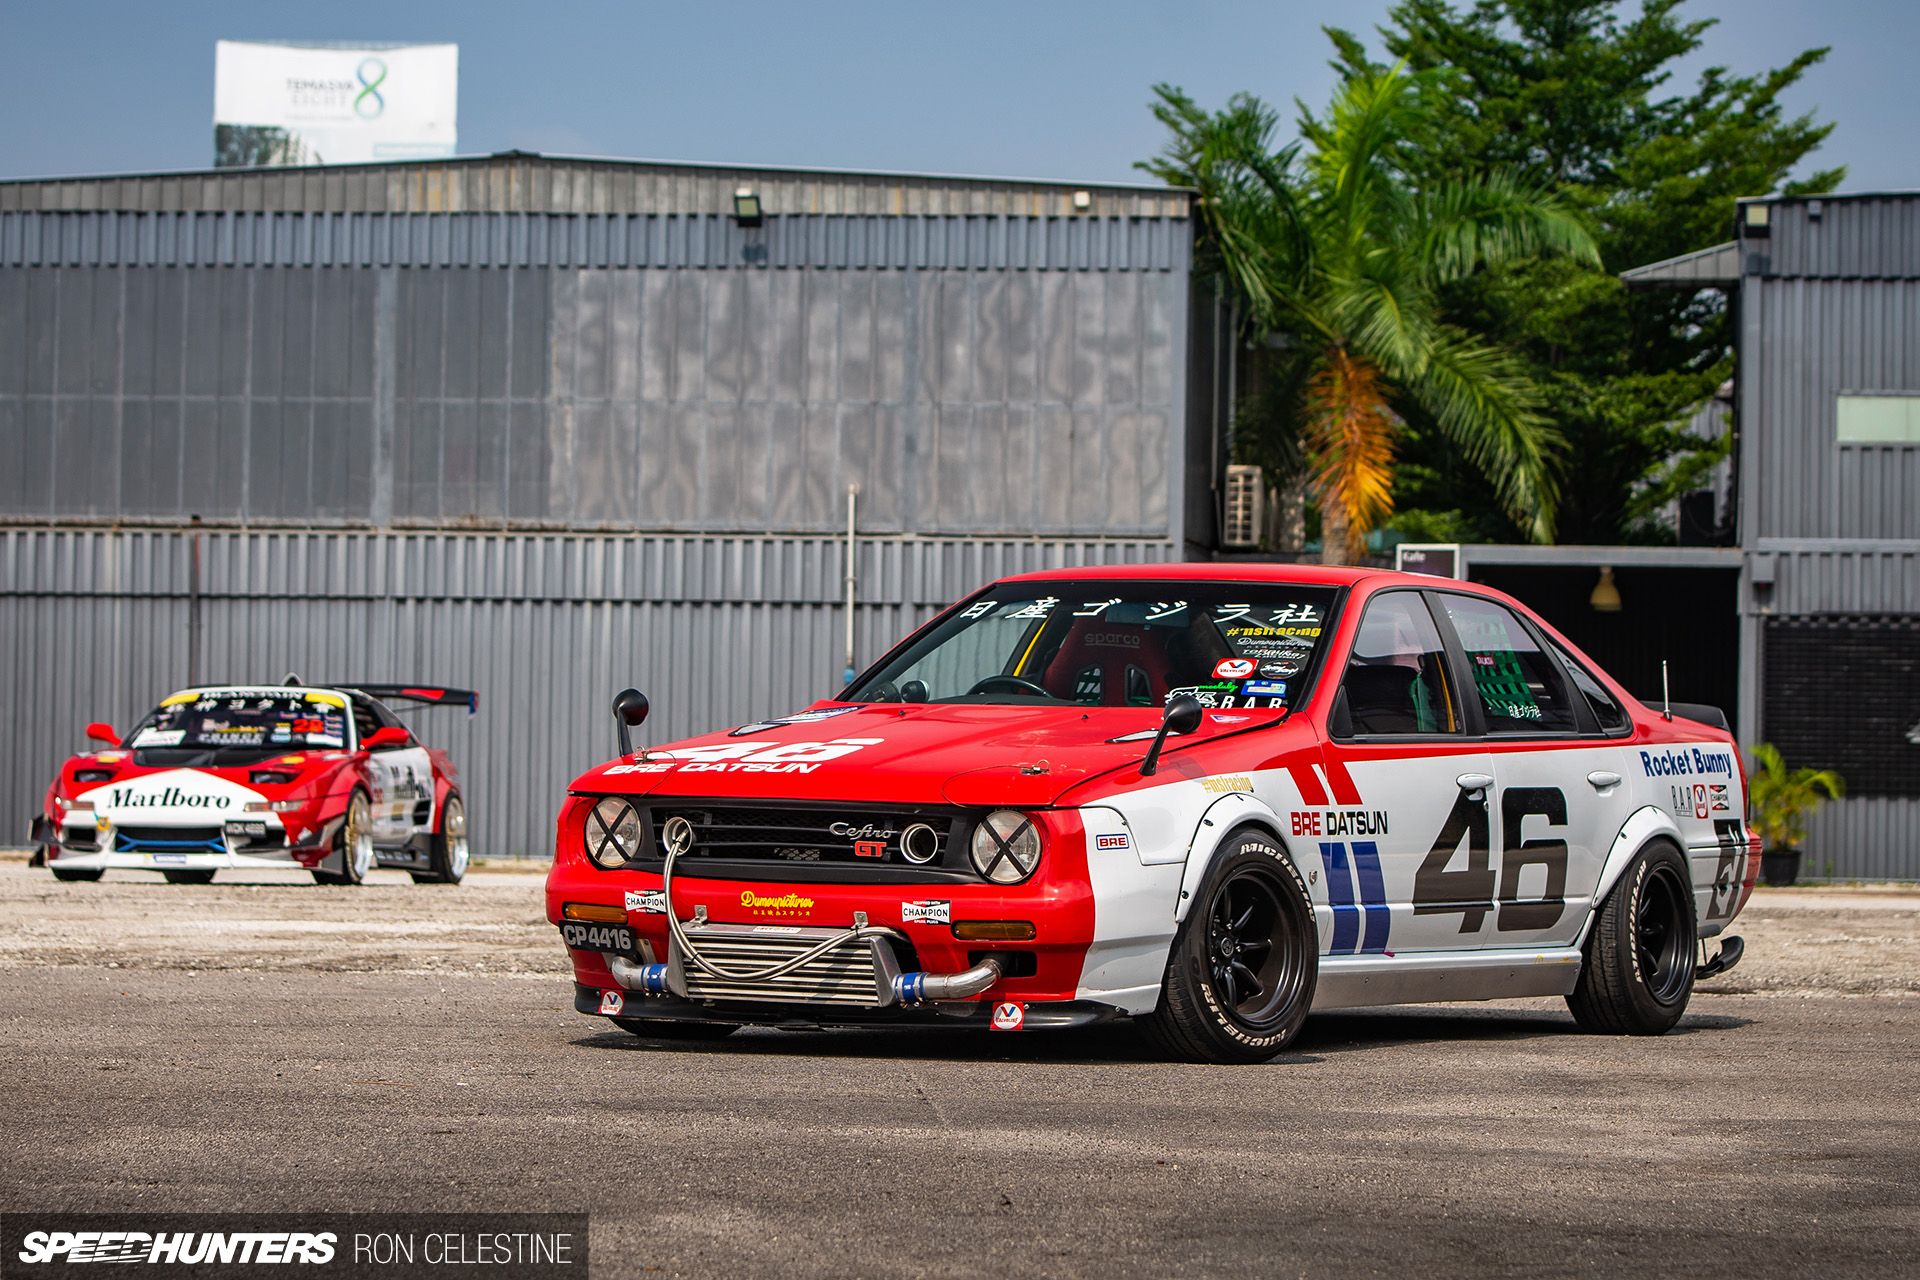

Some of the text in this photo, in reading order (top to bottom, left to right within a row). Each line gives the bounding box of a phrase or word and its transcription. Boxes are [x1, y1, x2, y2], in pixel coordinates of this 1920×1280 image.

[1085, 633, 1141, 645] sparco
[292, 719, 324, 733] 28
[634, 738, 885, 762] 46
[602, 763, 822, 775] BRE DATSUN
[1640, 748, 1732, 779] Rocket Bunny
[108, 787, 230, 809] Marlboro
[829, 822, 897, 840] Cefiro
[1290, 811, 1388, 836] BRE DATSUN
[855, 841, 887, 857] GT
[1099, 837, 1126, 847] BRE
[1412, 787, 1568, 934] 46
[626, 897, 665, 906] CHAMPION
[903, 907, 948, 917] CHAMPION
